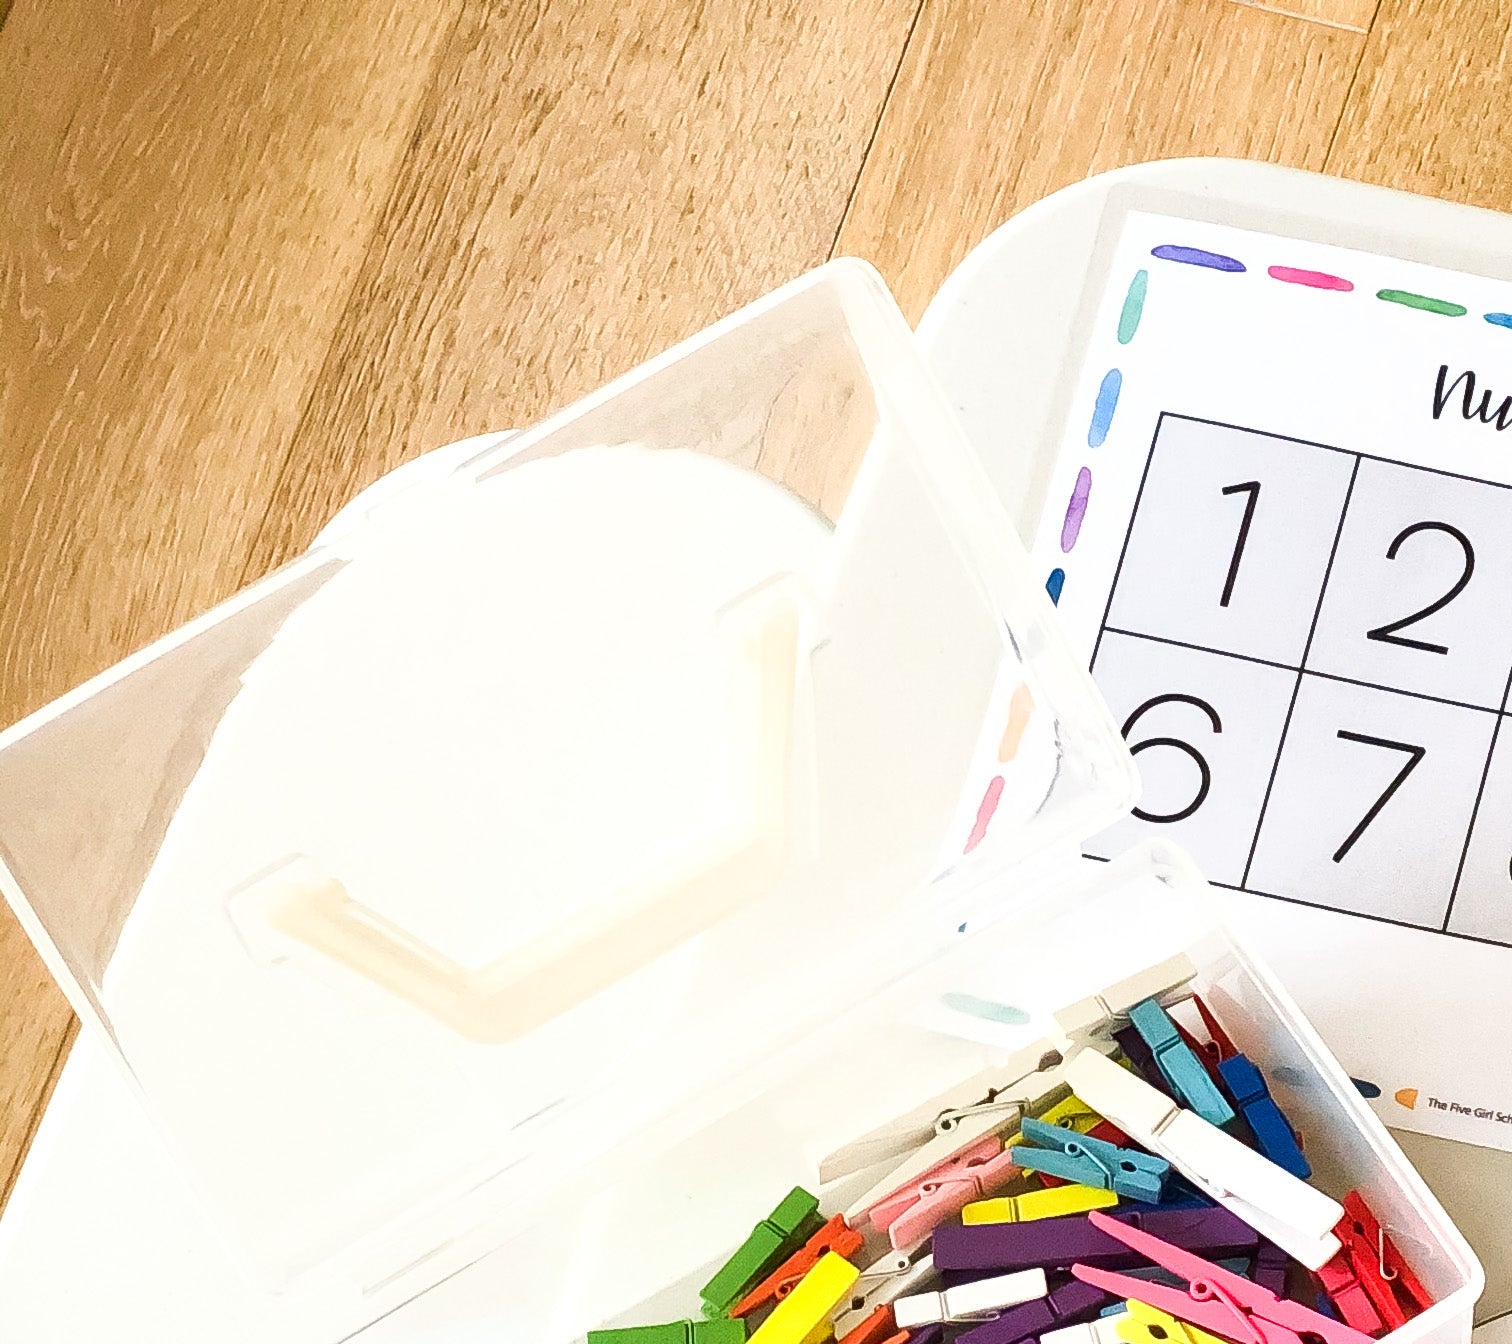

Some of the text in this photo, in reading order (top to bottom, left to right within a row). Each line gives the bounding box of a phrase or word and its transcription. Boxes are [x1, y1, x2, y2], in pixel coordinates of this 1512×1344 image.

[1220, 481, 1261, 607] 1
[1366, 521, 1476, 655] 2
[1120, 693, 1222, 824] 6
[1332, 729, 1426, 864] 7
[1428, 1097, 1448, 1111] The
[1450, 1102, 1472, 1115] Five
[1474, 1108, 1494, 1120] Girl
